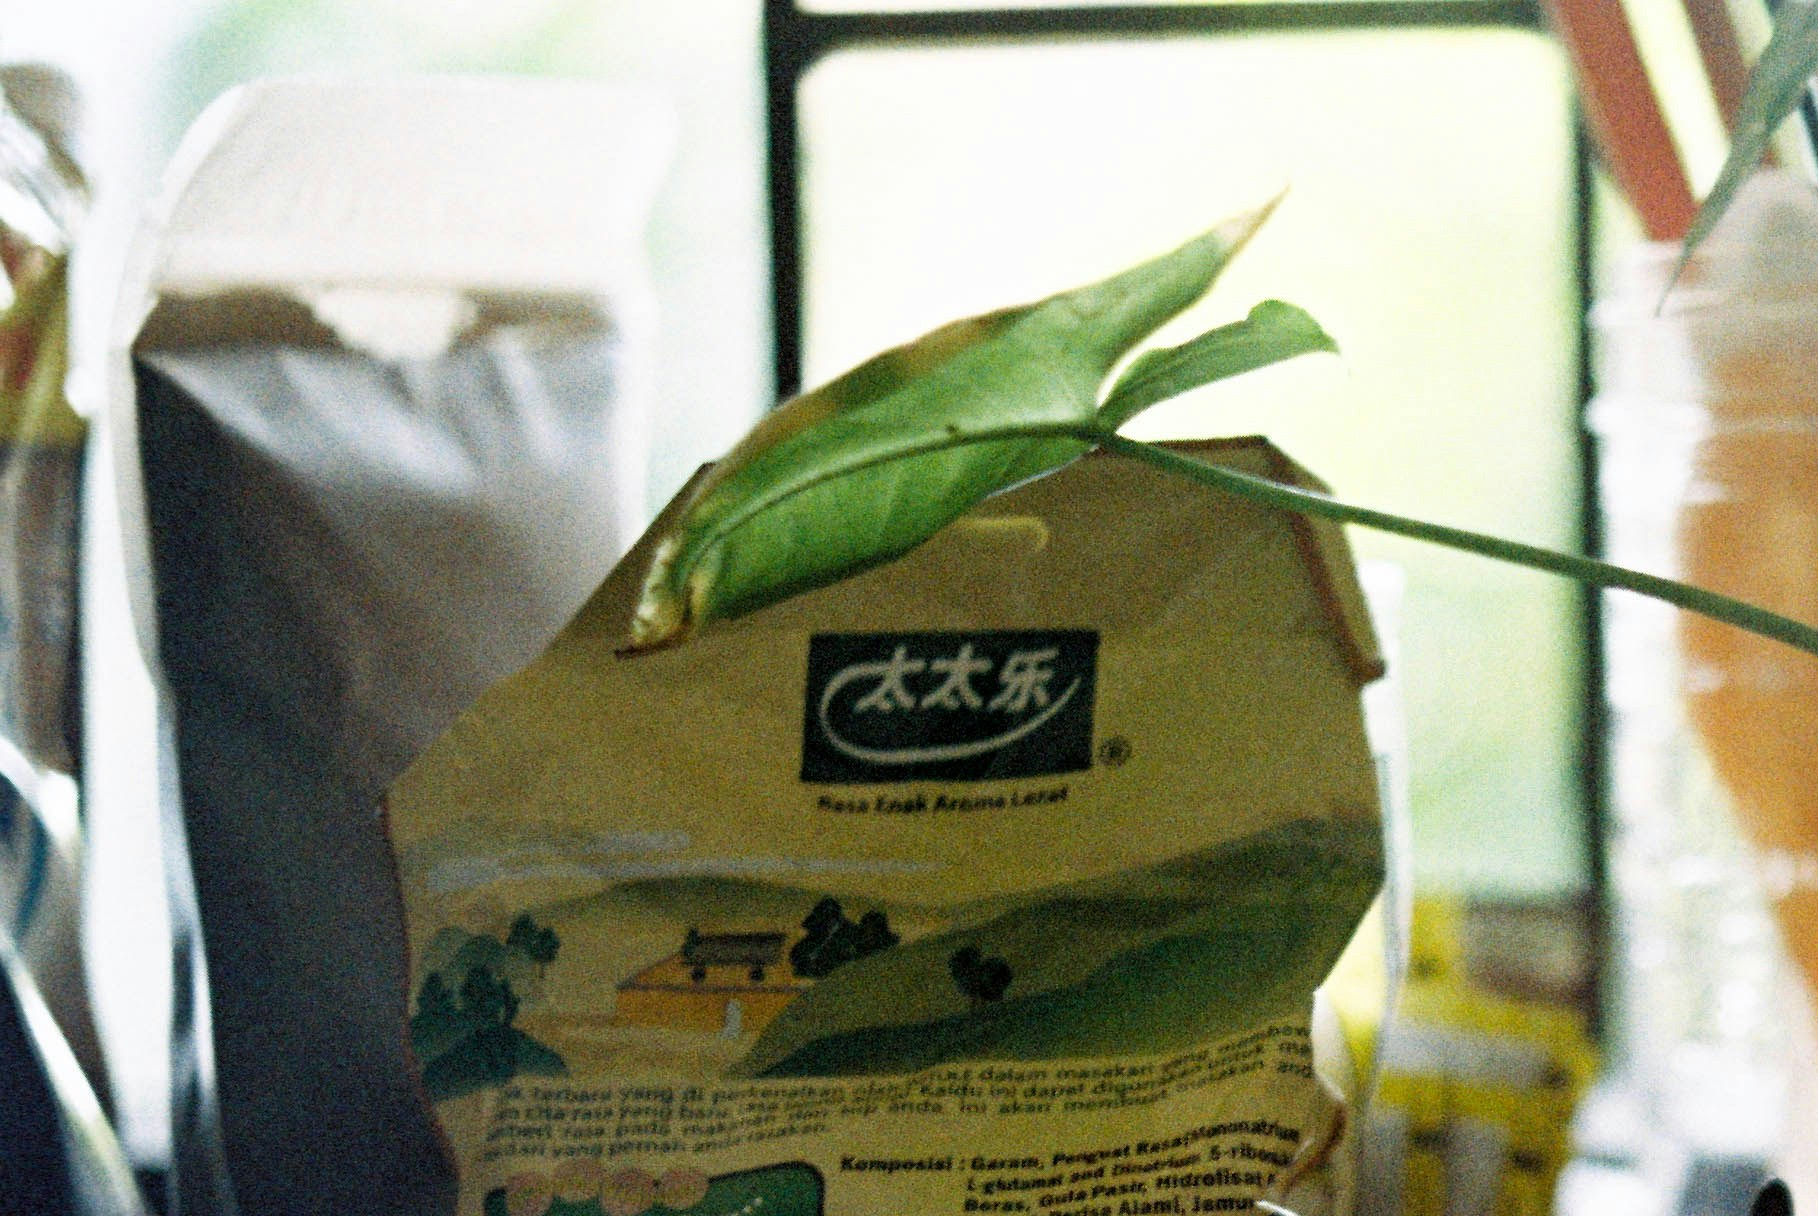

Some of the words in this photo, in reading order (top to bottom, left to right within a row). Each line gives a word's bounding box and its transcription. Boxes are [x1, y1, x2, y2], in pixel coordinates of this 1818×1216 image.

[853, 643, 1061, 714] 太太乐
[818, 793, 869, 812] Rasa
[876, 793, 927, 814] Enak
[935, 791, 1005, 812] Aroma
[1011, 787, 1069, 807] Lezat
[840, 1154, 953, 1173] Komposisi
[1051, 1144, 1132, 1167] Penguat
[1039, 1189, 1088, 1208] Gula
